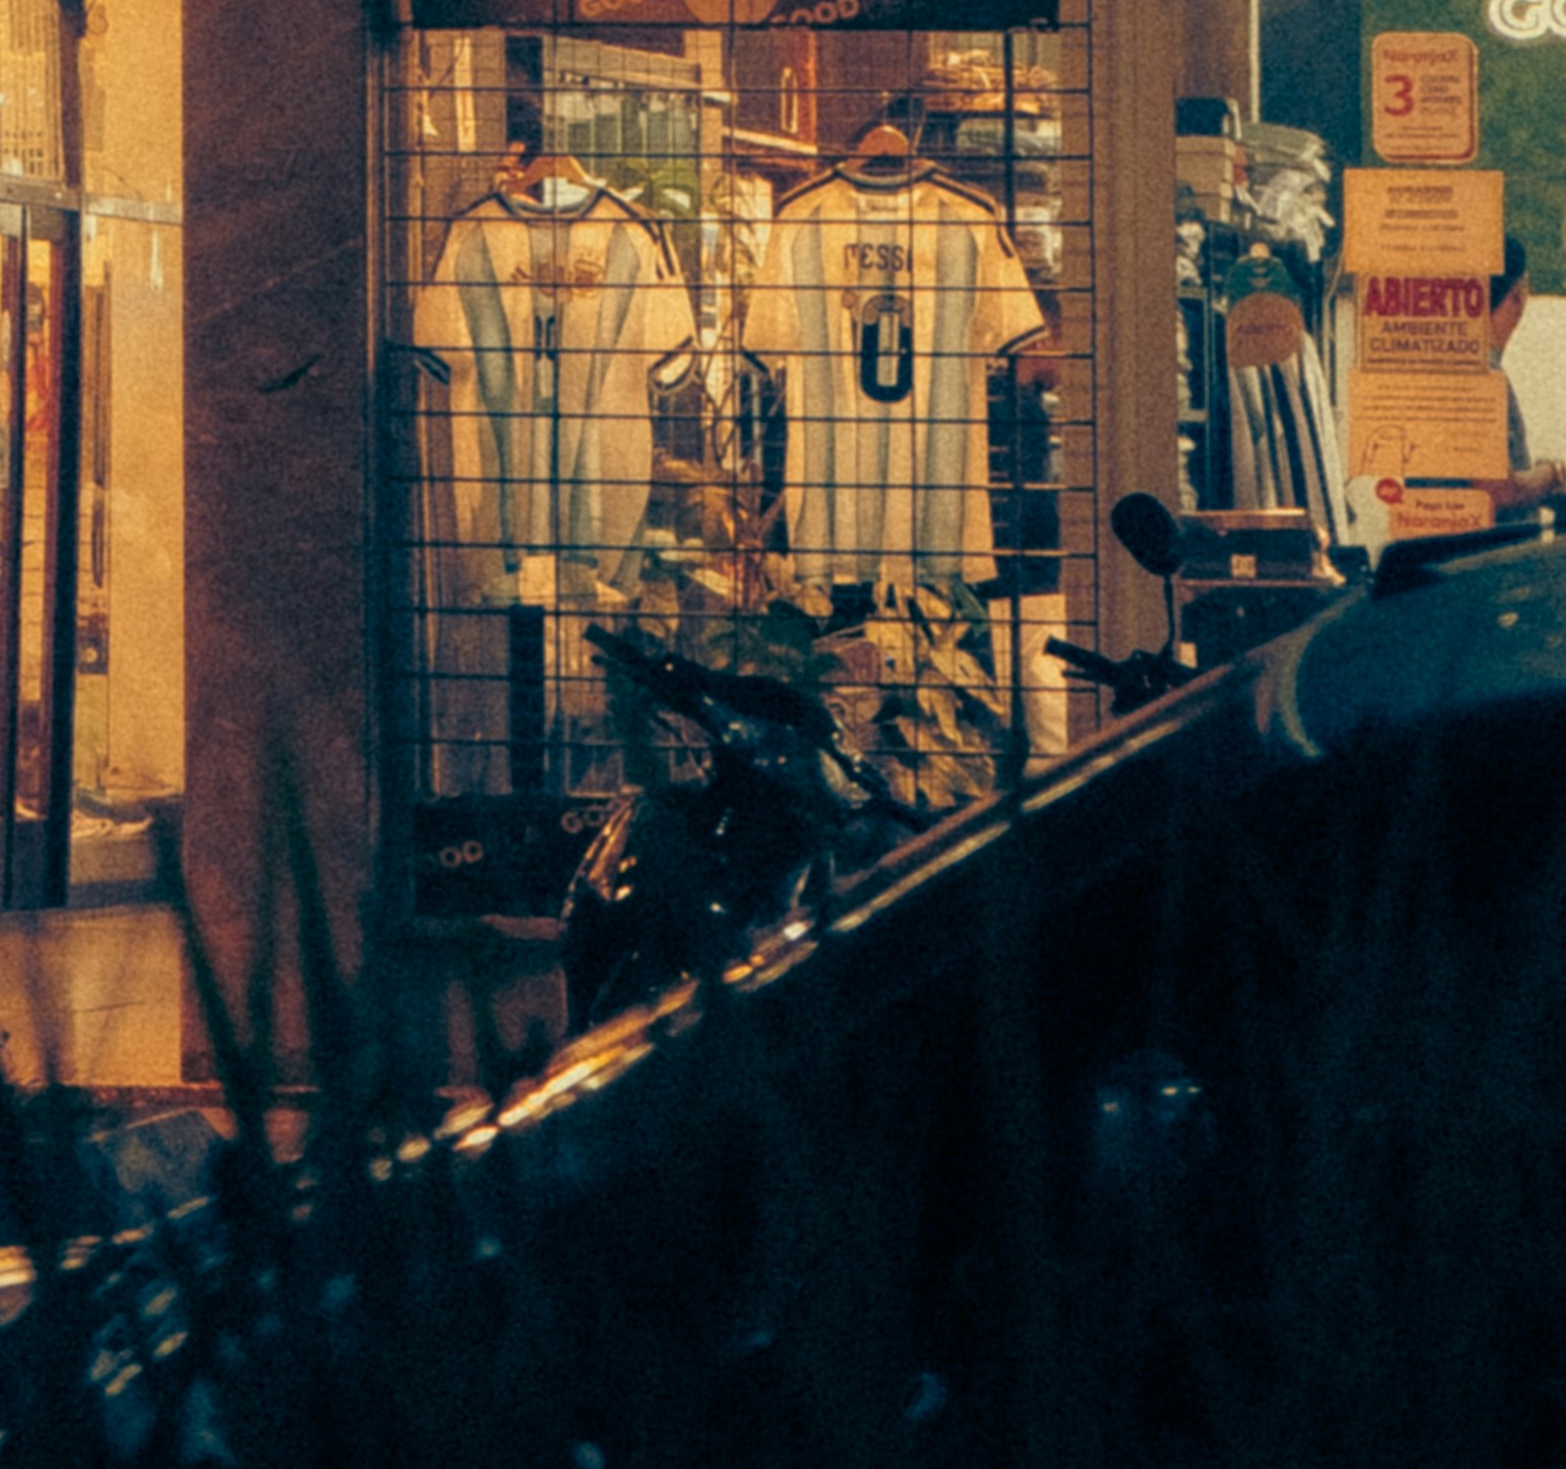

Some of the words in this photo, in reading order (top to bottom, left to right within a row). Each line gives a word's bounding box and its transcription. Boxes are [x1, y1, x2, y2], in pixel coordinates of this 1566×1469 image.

[1383, 73, 1415, 118] 3
[1364, 275, 1486, 319] ABIERTO
[1381, 321, 1469, 336] AMBIENTE
[1368, 336, 1481, 356] CLIMATIZADO
